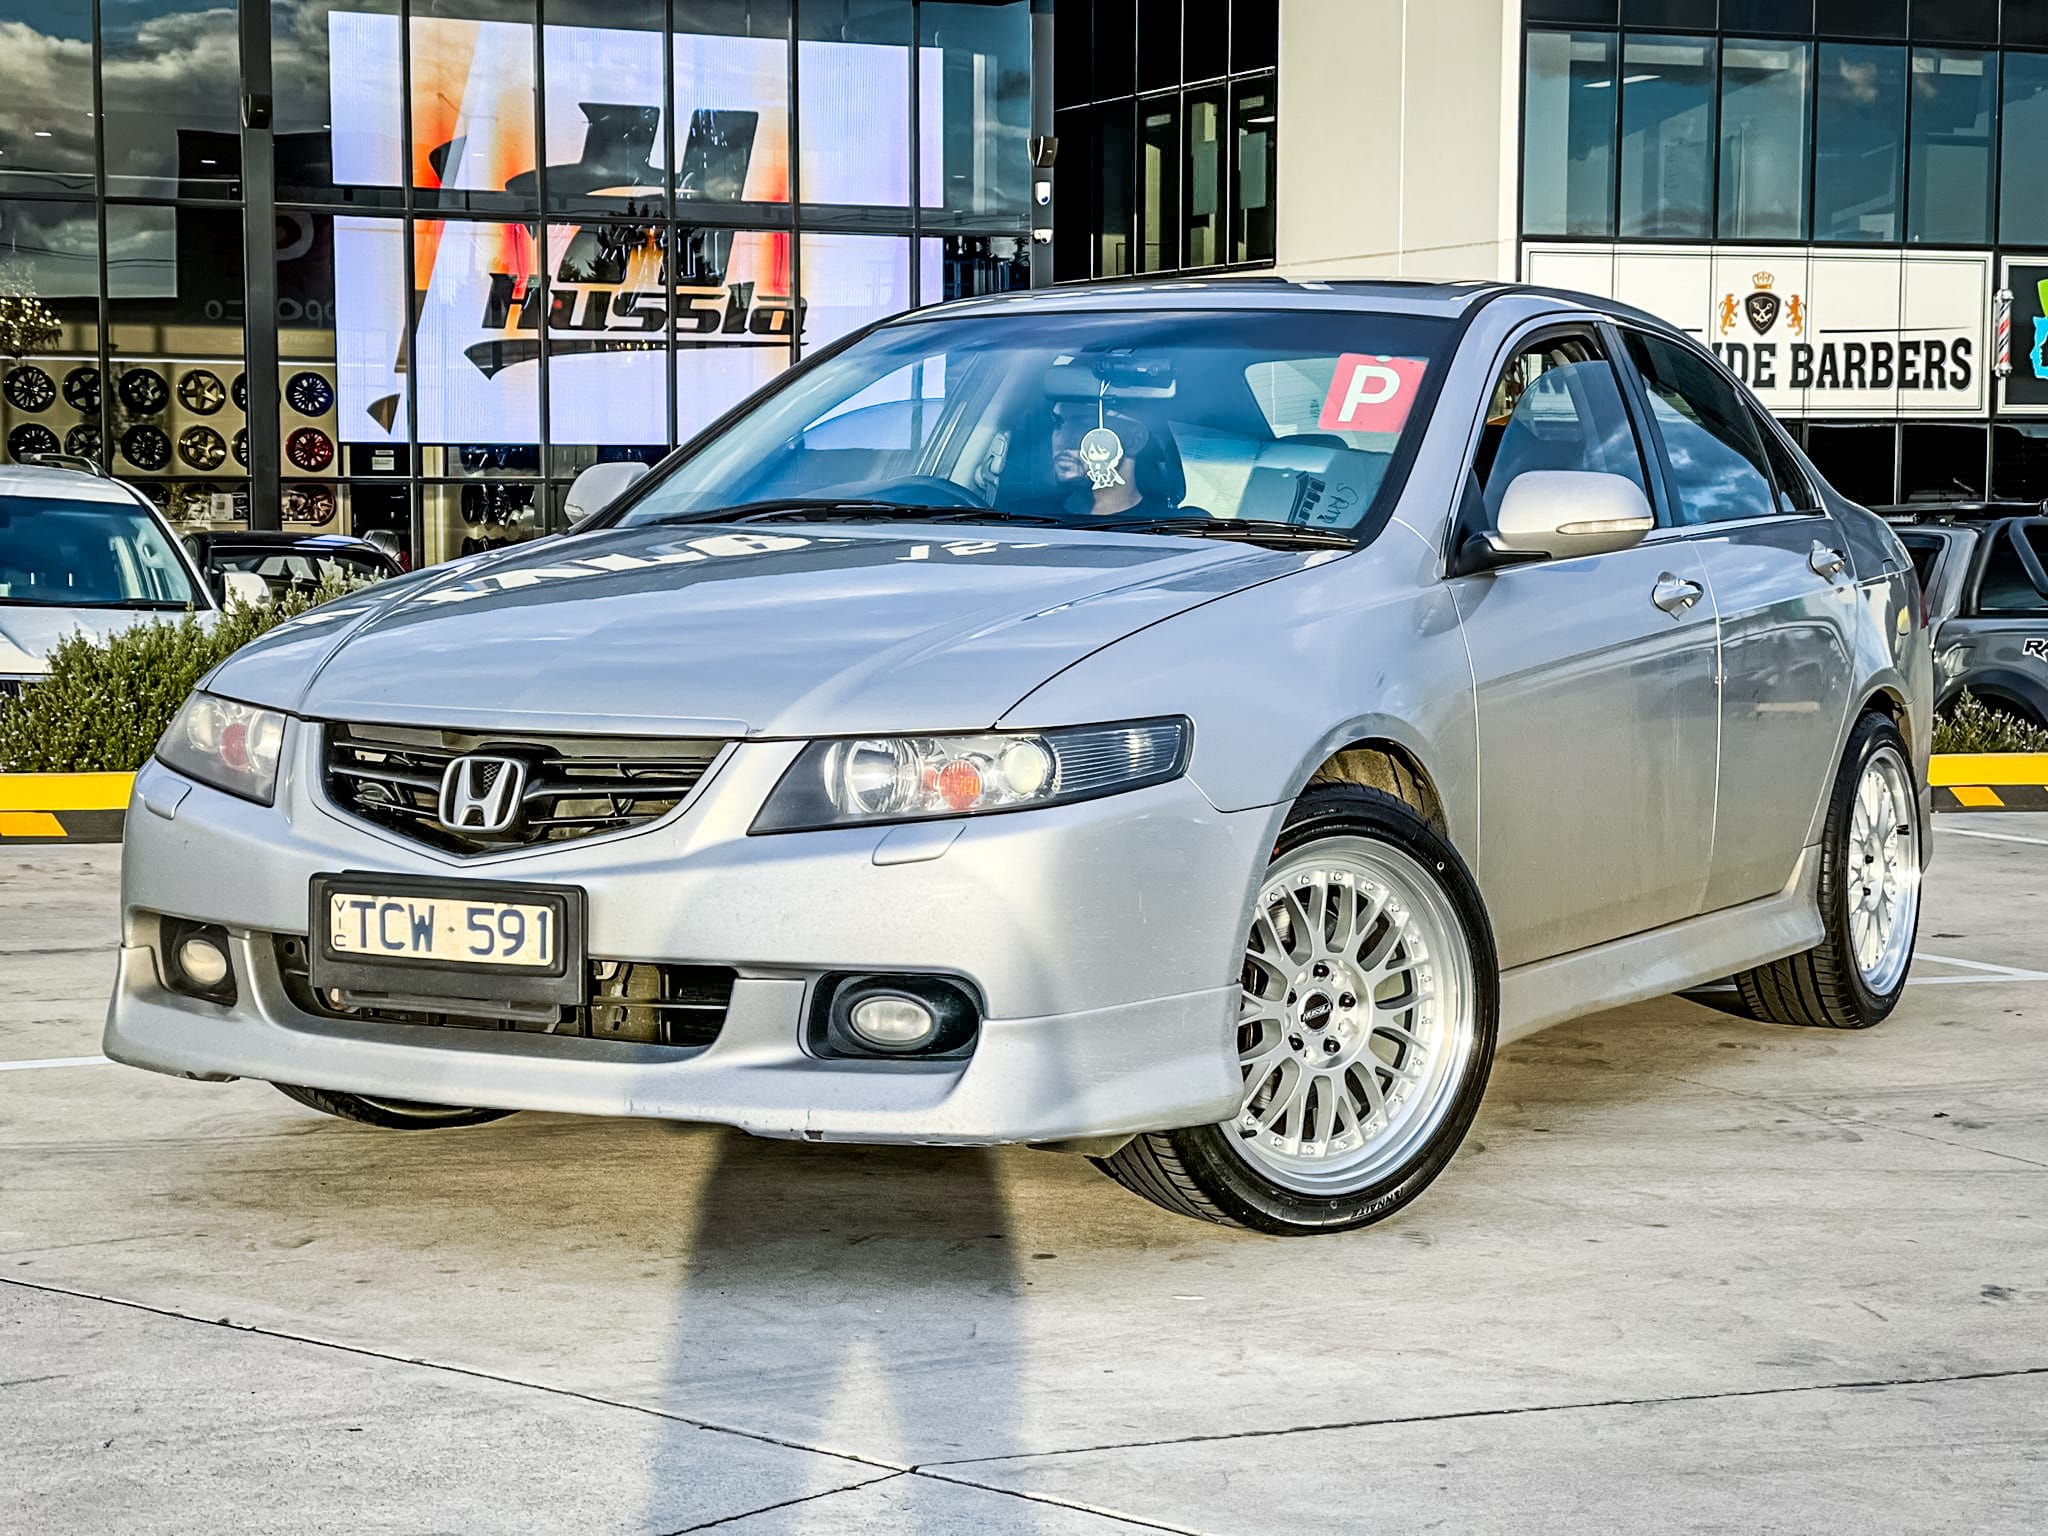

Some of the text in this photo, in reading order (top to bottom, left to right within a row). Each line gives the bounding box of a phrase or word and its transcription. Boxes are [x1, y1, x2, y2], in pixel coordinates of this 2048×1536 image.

[1790, 338, 1974, 390] BARBERS
[1337, 365, 1401, 422] P
[333, 898, 348, 948] VIC
